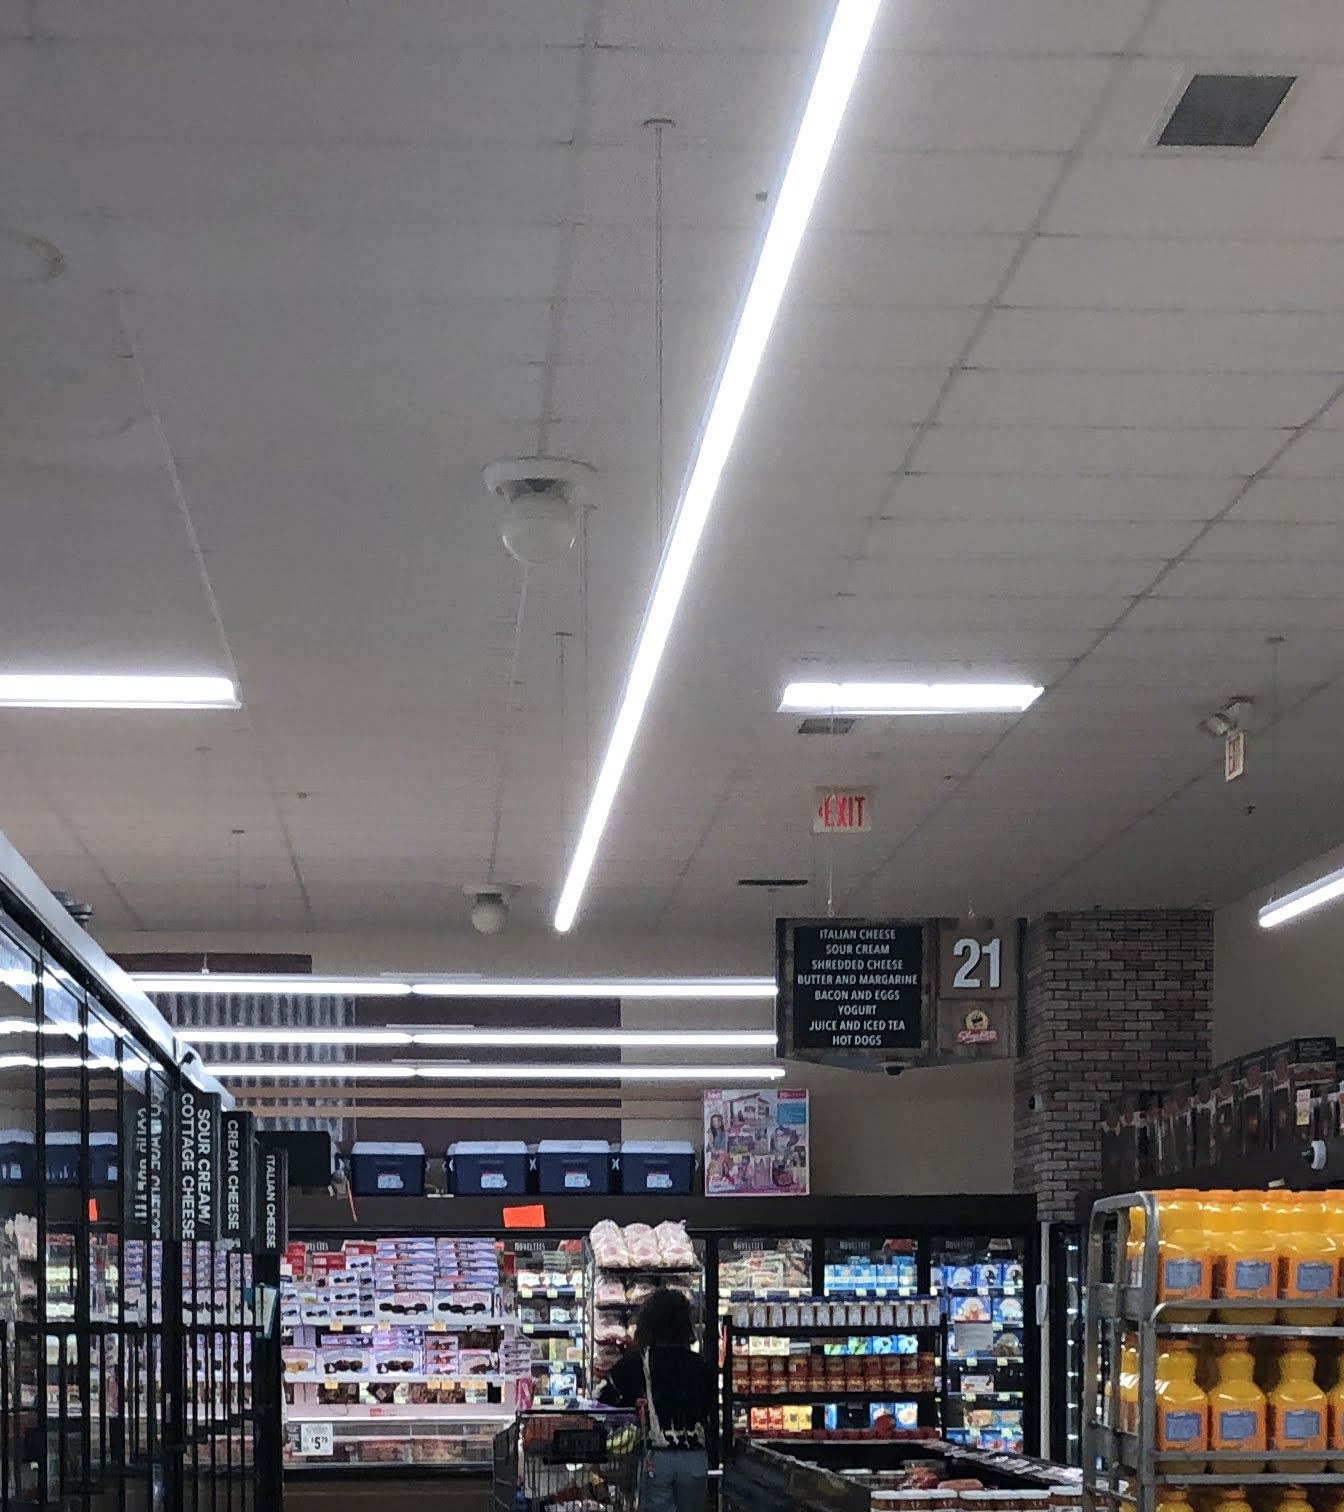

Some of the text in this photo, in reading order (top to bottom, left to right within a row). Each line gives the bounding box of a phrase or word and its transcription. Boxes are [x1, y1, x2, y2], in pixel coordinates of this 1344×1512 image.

[824, 796, 866, 827] EXIT
[819, 928, 896, 940] ITALIAN CHEESE
[825, 943, 890, 955] SOUR CREAM
[811, 959, 904, 971] SHREDDED CHEESE
[952, 937, 1001, 989] 21
[797, 974, 918, 985] BUTTER AND MARGARINE
[814, 989, 900, 1001] BACON AND EGGS
[837, 1004, 878, 1016] YOGURT
[809, 1020, 906, 1031] JUICE AND ICED TEA
[832, 1035, 882, 1046] HOT DOGS
[197, 1108, 211, 1155] SOUR
[227, 1119, 239, 1172] CREAM
[181, 1092, 195, 1240] COTTAGE CHEESE
[228, 1175, 240, 1231] CHEESE
[266, 1154, 276, 1249] ITALIAN CHEESE
